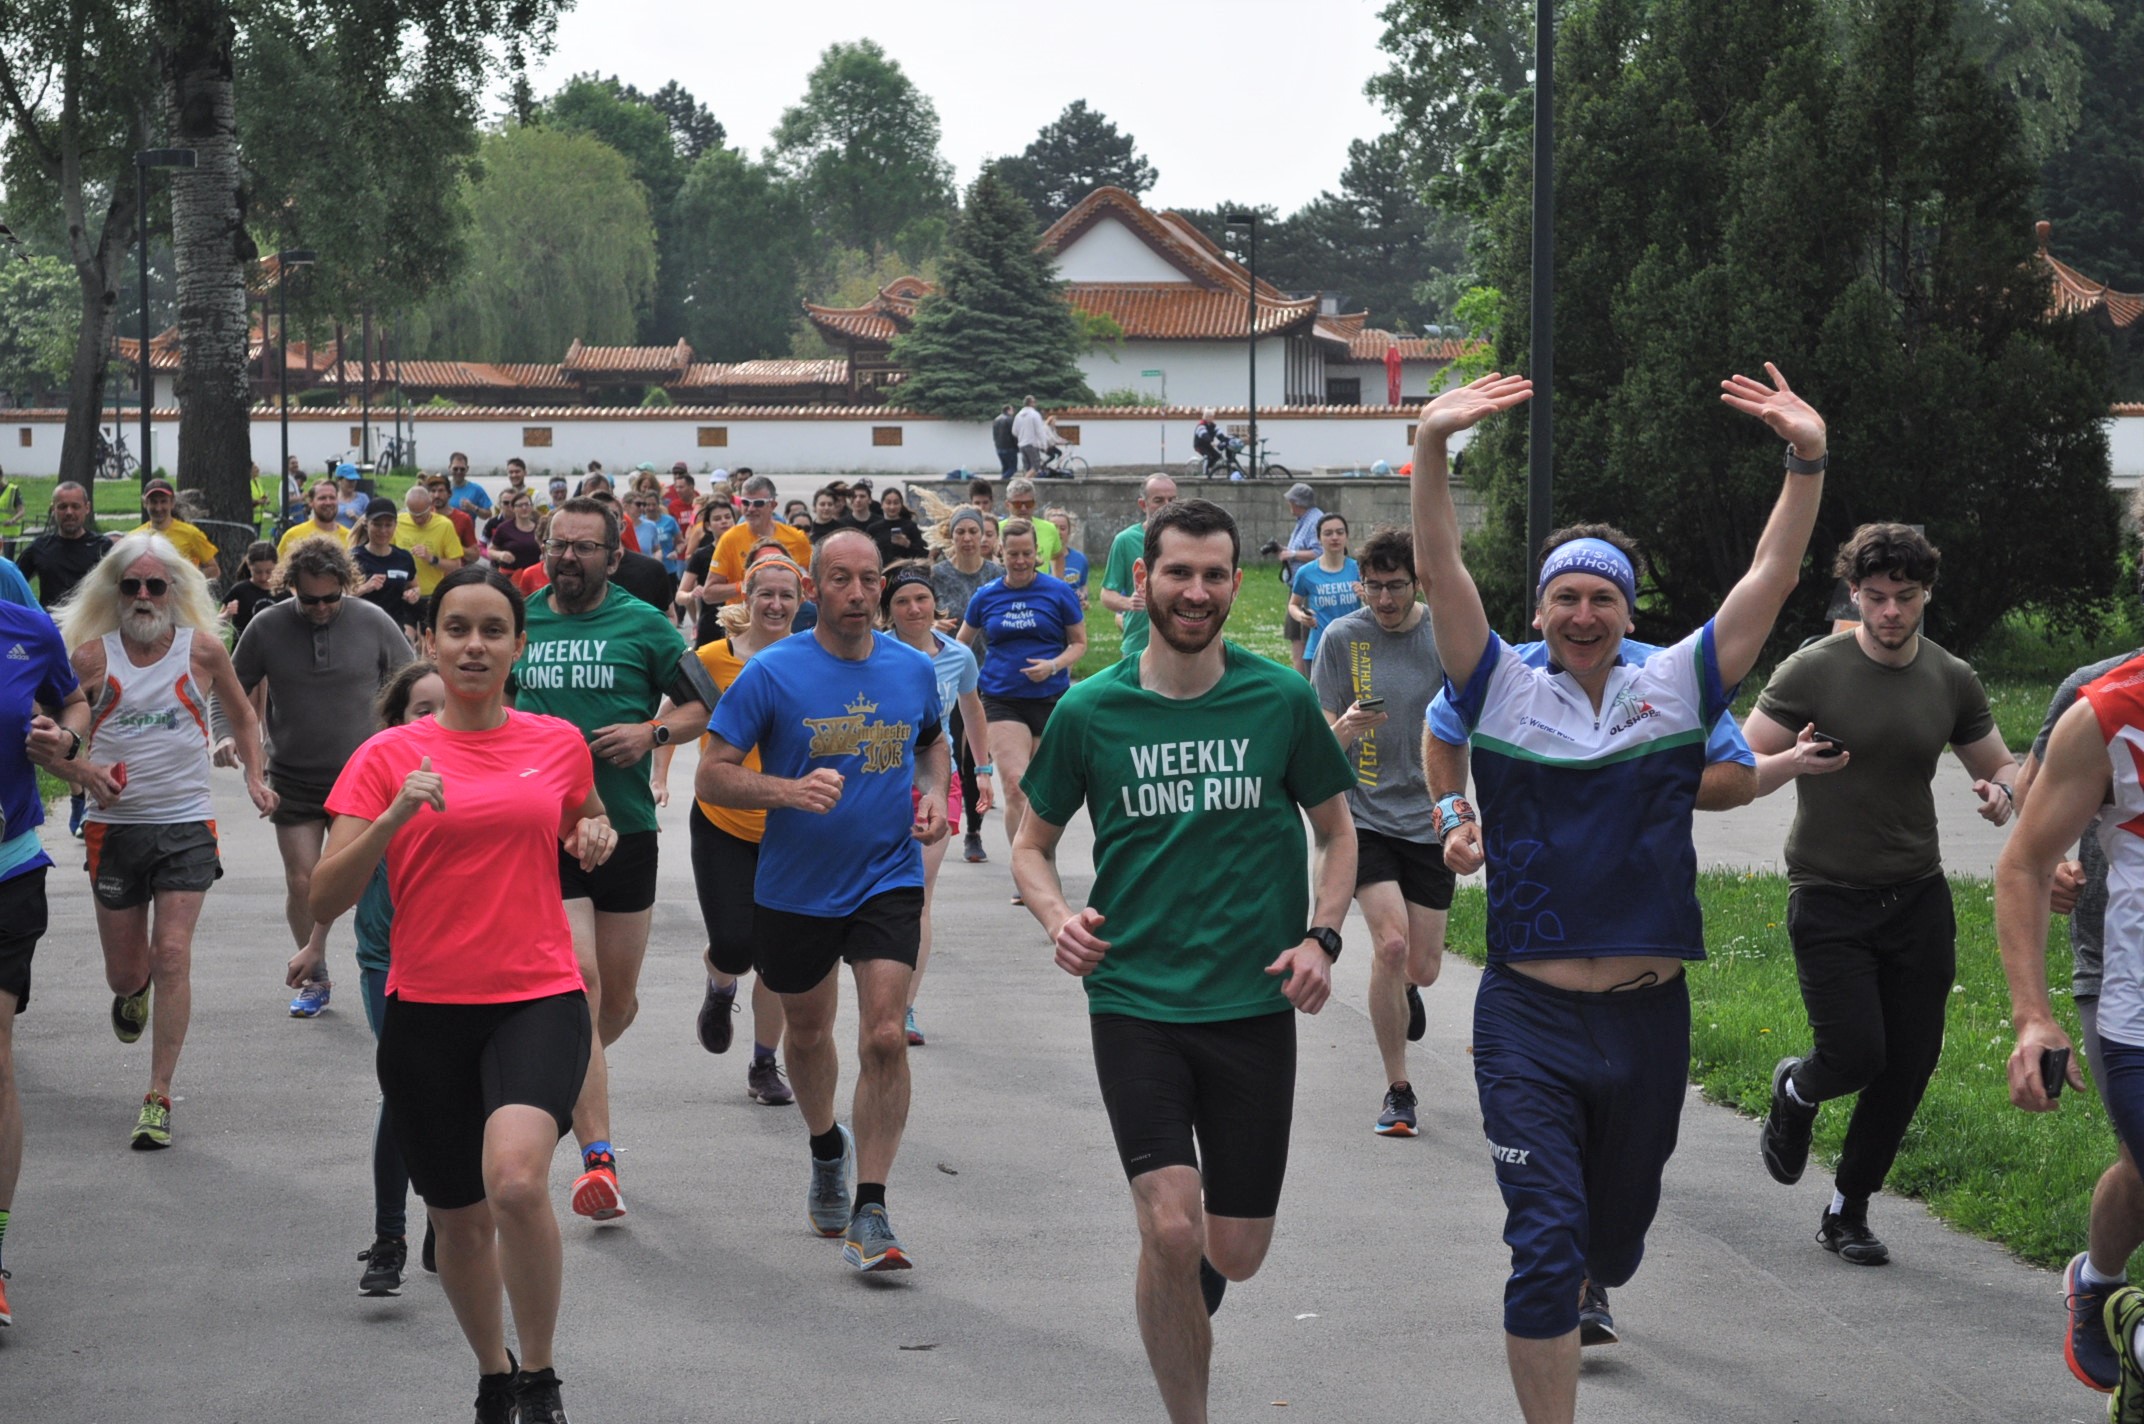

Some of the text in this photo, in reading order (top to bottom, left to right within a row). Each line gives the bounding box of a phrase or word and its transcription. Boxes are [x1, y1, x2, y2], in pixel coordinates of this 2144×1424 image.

[1541, 556, 1618, 582] MARATHON
[1315, 593, 1358, 607] LONG RUN
[1316, 582, 1353, 595] WEEKLY
[1000, 618, 1037, 629] matters
[527, 640, 607, 663] WEEKLY
[518, 664, 614, 690] LONG RUN
[802, 713, 912, 758] Winchester
[861, 739, 903, 774] 10k
[1129, 738, 1250, 779] WEEKLY
[1121, 776, 1262, 818] LONG RUN
